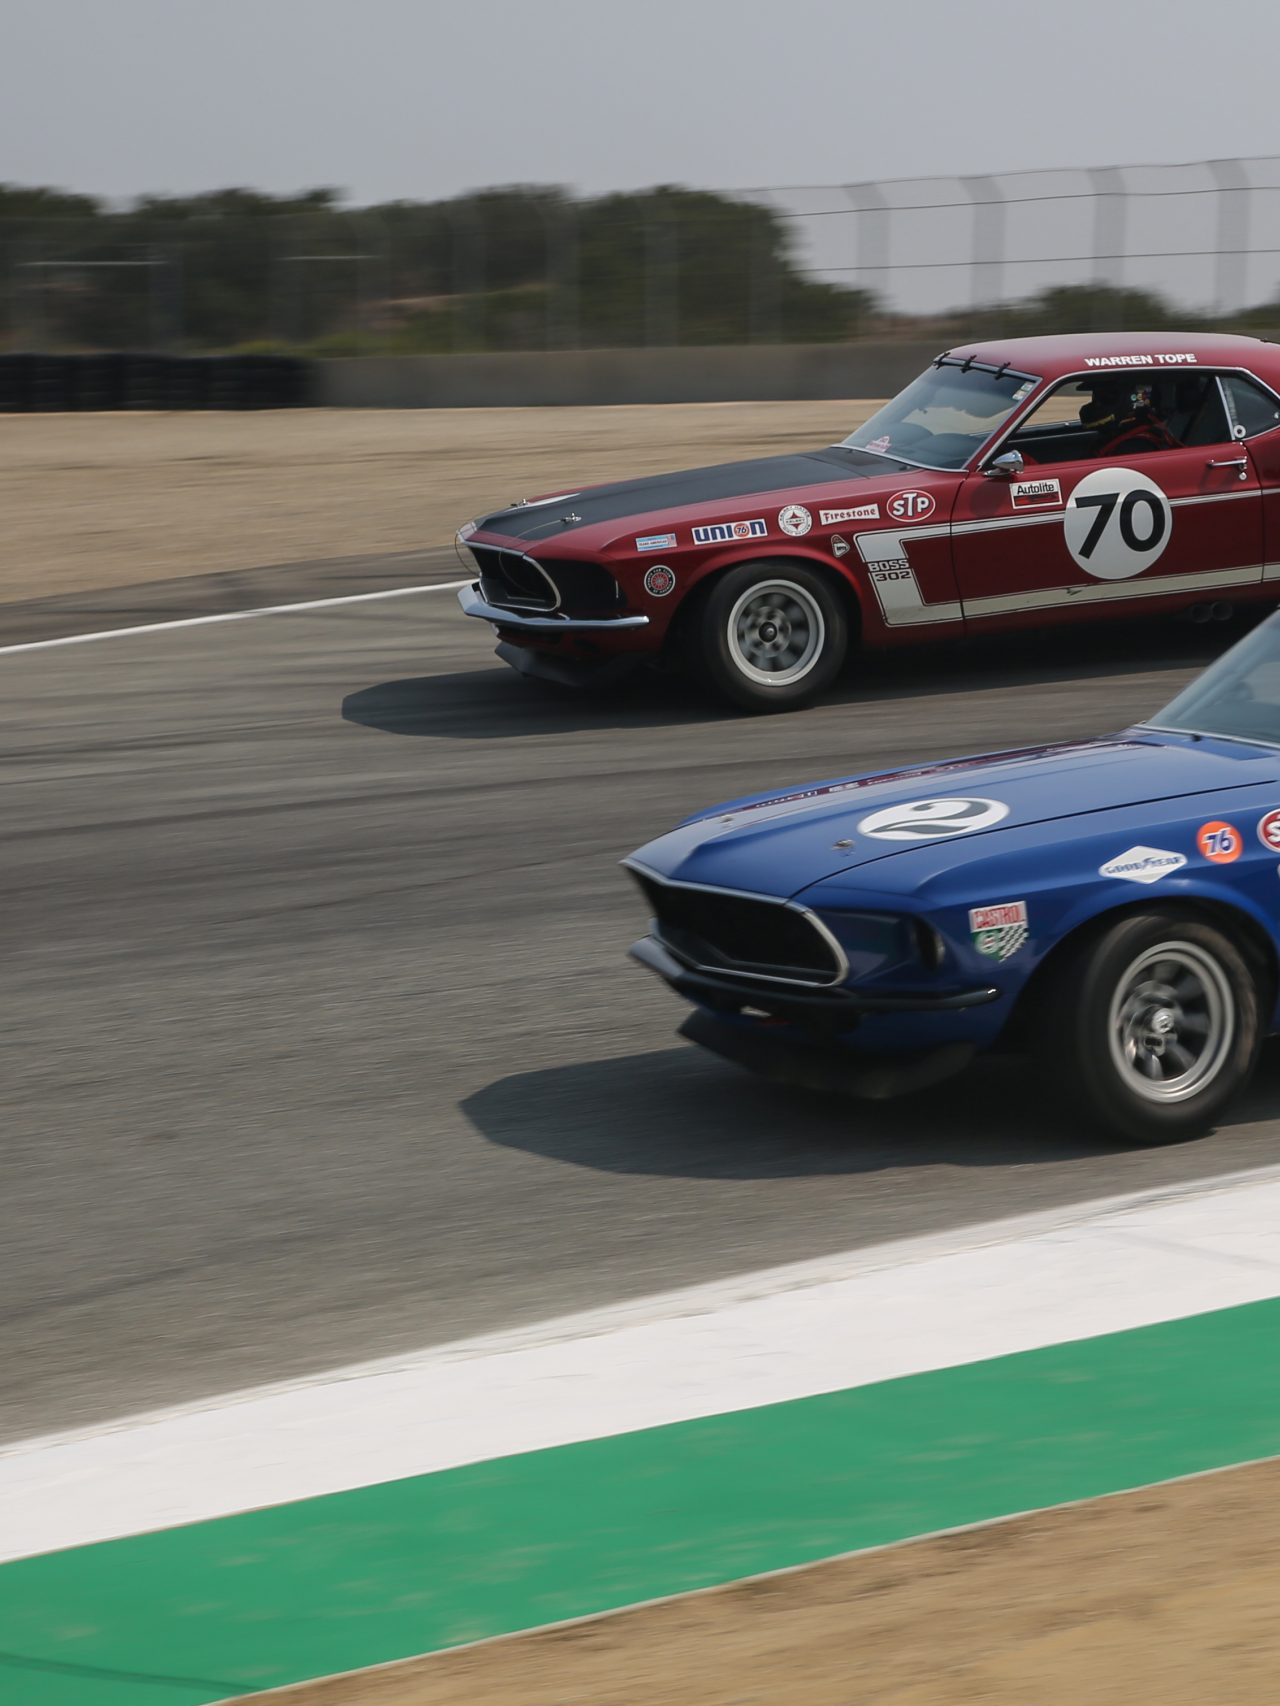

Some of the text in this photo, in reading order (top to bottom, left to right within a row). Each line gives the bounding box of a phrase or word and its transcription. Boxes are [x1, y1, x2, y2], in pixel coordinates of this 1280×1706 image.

[1084, 353, 1197, 366] WARREN TOPE
[1017, 482, 1054, 495] Autolite
[892, 492, 930, 517] STP
[823, 507, 876, 523] Firestone
[1074, 488, 1166, 560] 70
[868, 559, 910, 572] BOSS
[875, 570, 911, 582] 302
[863, 799, 990, 836] 2
[1201, 826, 1237, 857] 76
